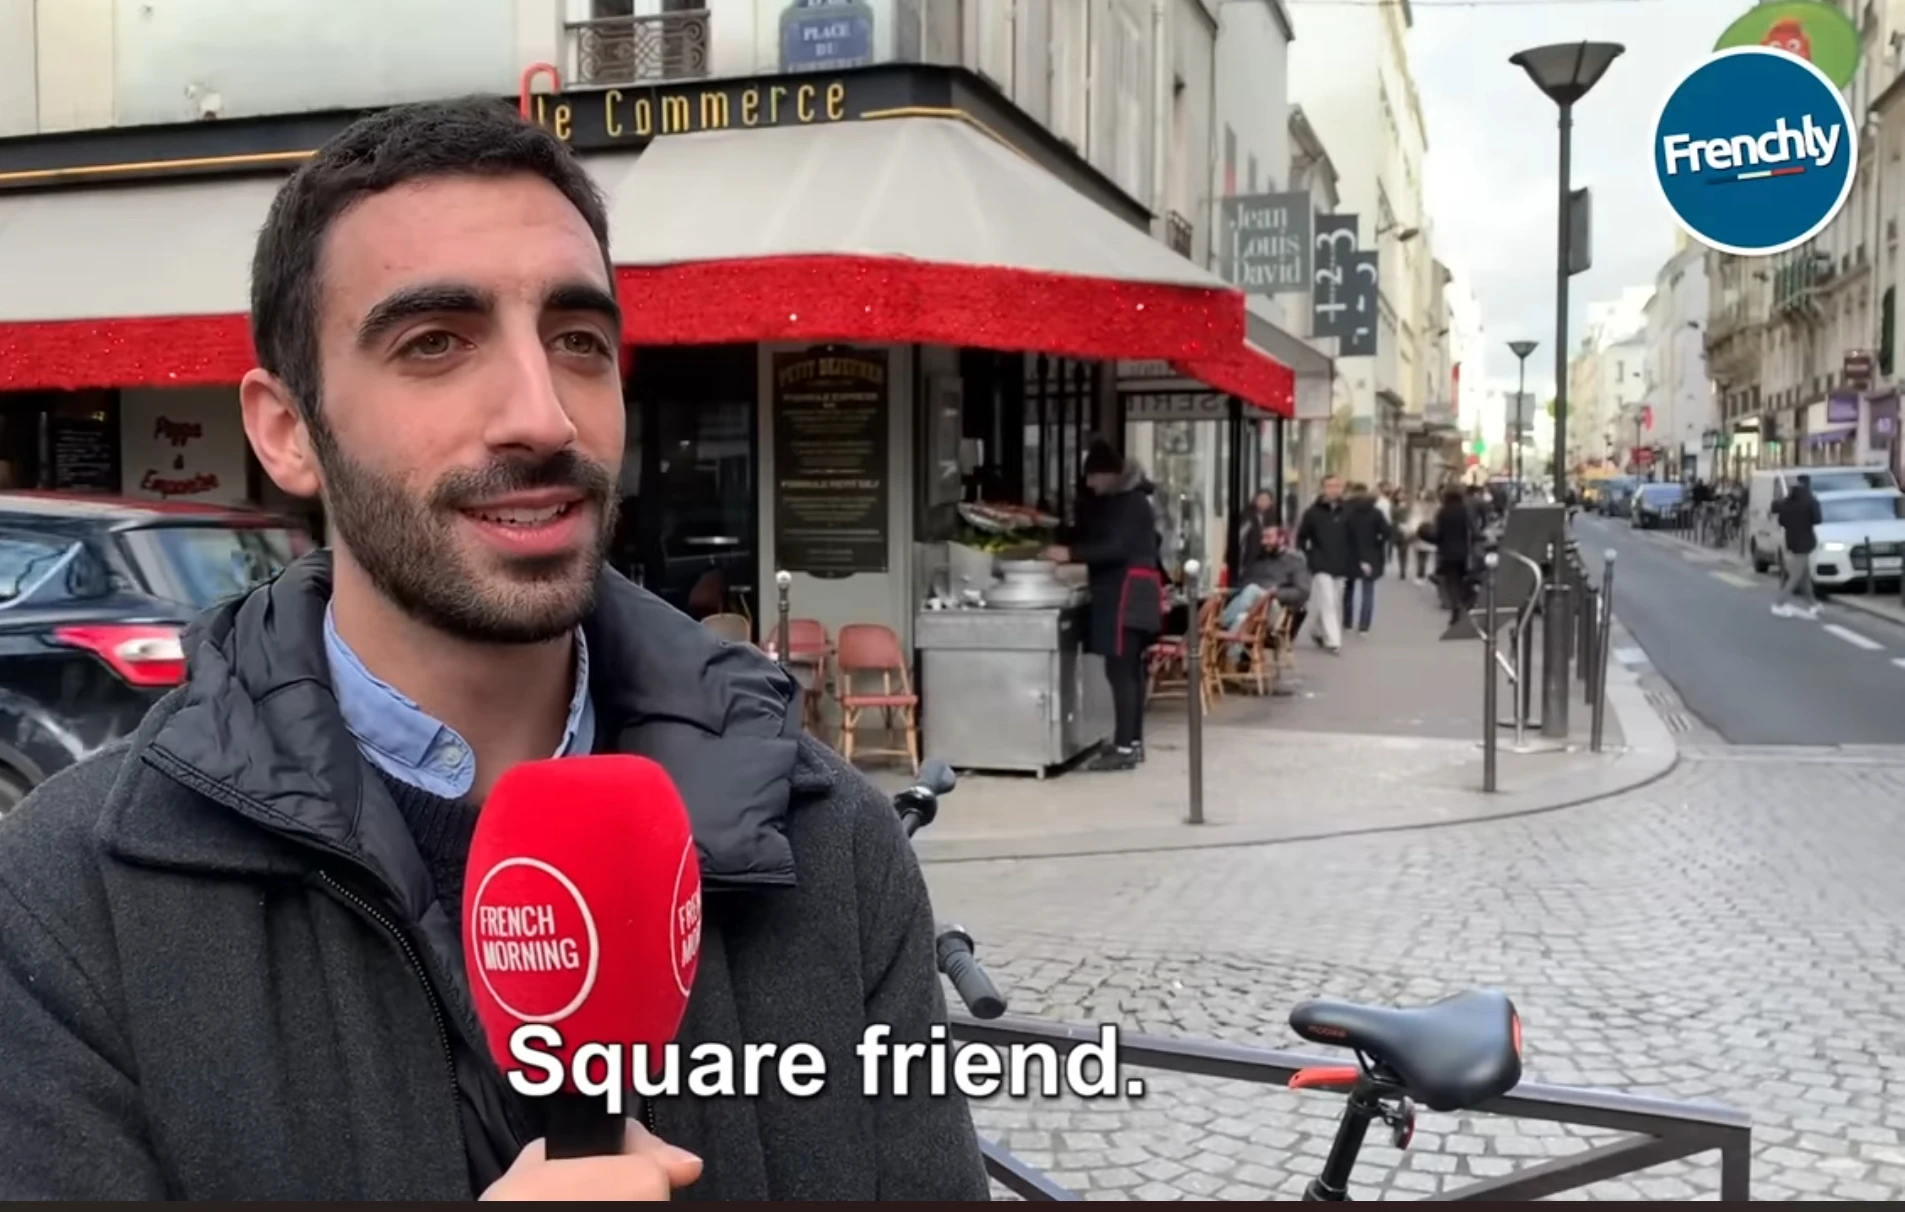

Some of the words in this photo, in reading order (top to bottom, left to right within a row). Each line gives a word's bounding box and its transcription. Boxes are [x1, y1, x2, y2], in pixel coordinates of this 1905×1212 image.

[803, 22, 852, 41] PLACE
[815, 42, 839, 57] DU
[605, 82, 845, 138] Commerce
[1230, 203, 1288, 231] Jean
[1233, 230, 1301, 258] Louis
[1233, 256, 1301, 285] David
[480, 904, 556, 937] FRENCH
[482, 938, 580, 972] MORNING
